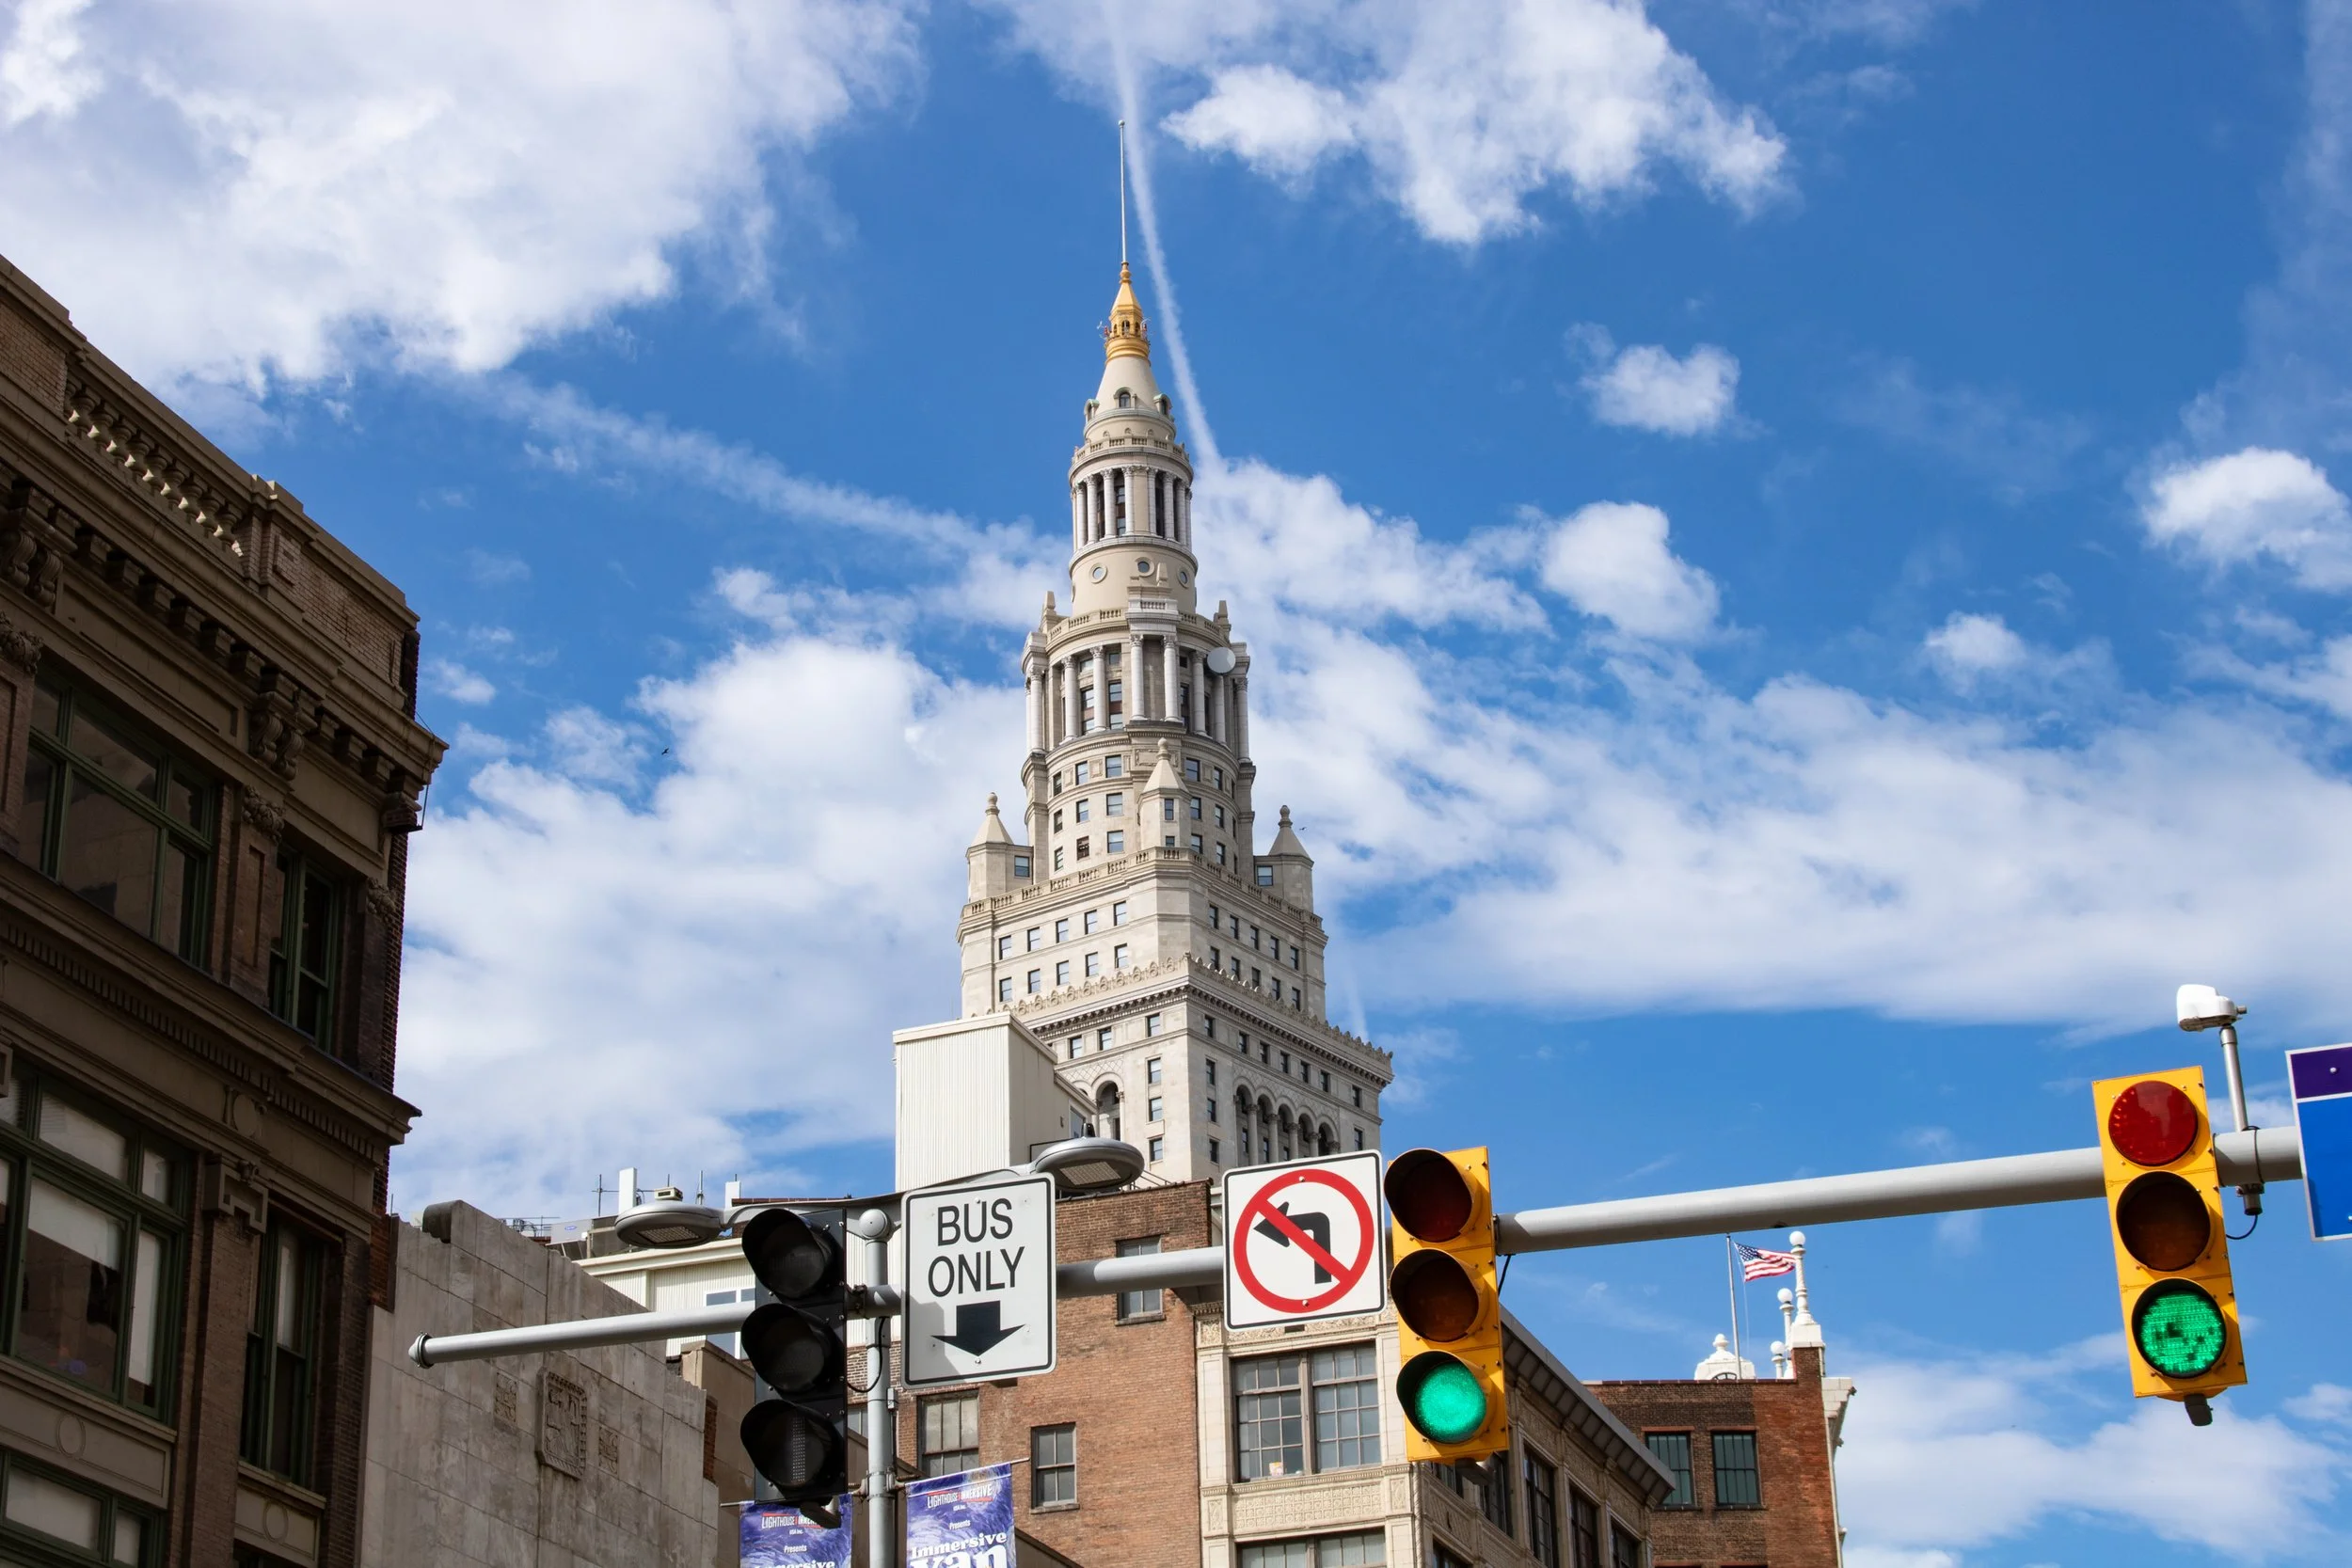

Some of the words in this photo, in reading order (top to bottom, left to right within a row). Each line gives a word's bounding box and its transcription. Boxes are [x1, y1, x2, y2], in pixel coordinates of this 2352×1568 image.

[937, 1197, 1013, 1246] BUS
[928, 1246, 1025, 1297] ONLY
[927, 1493, 958, 1509] LIGHTHOUSE
[961, 1484, 993, 1499] IMMERSIVE
[761, 1515, 794, 1528] LIGHTHOUSE
[949, 1520, 971, 1530] Presents
[784, 1544, 807, 1553] Presents
[911, 1532, 1008, 1559] Immersive
